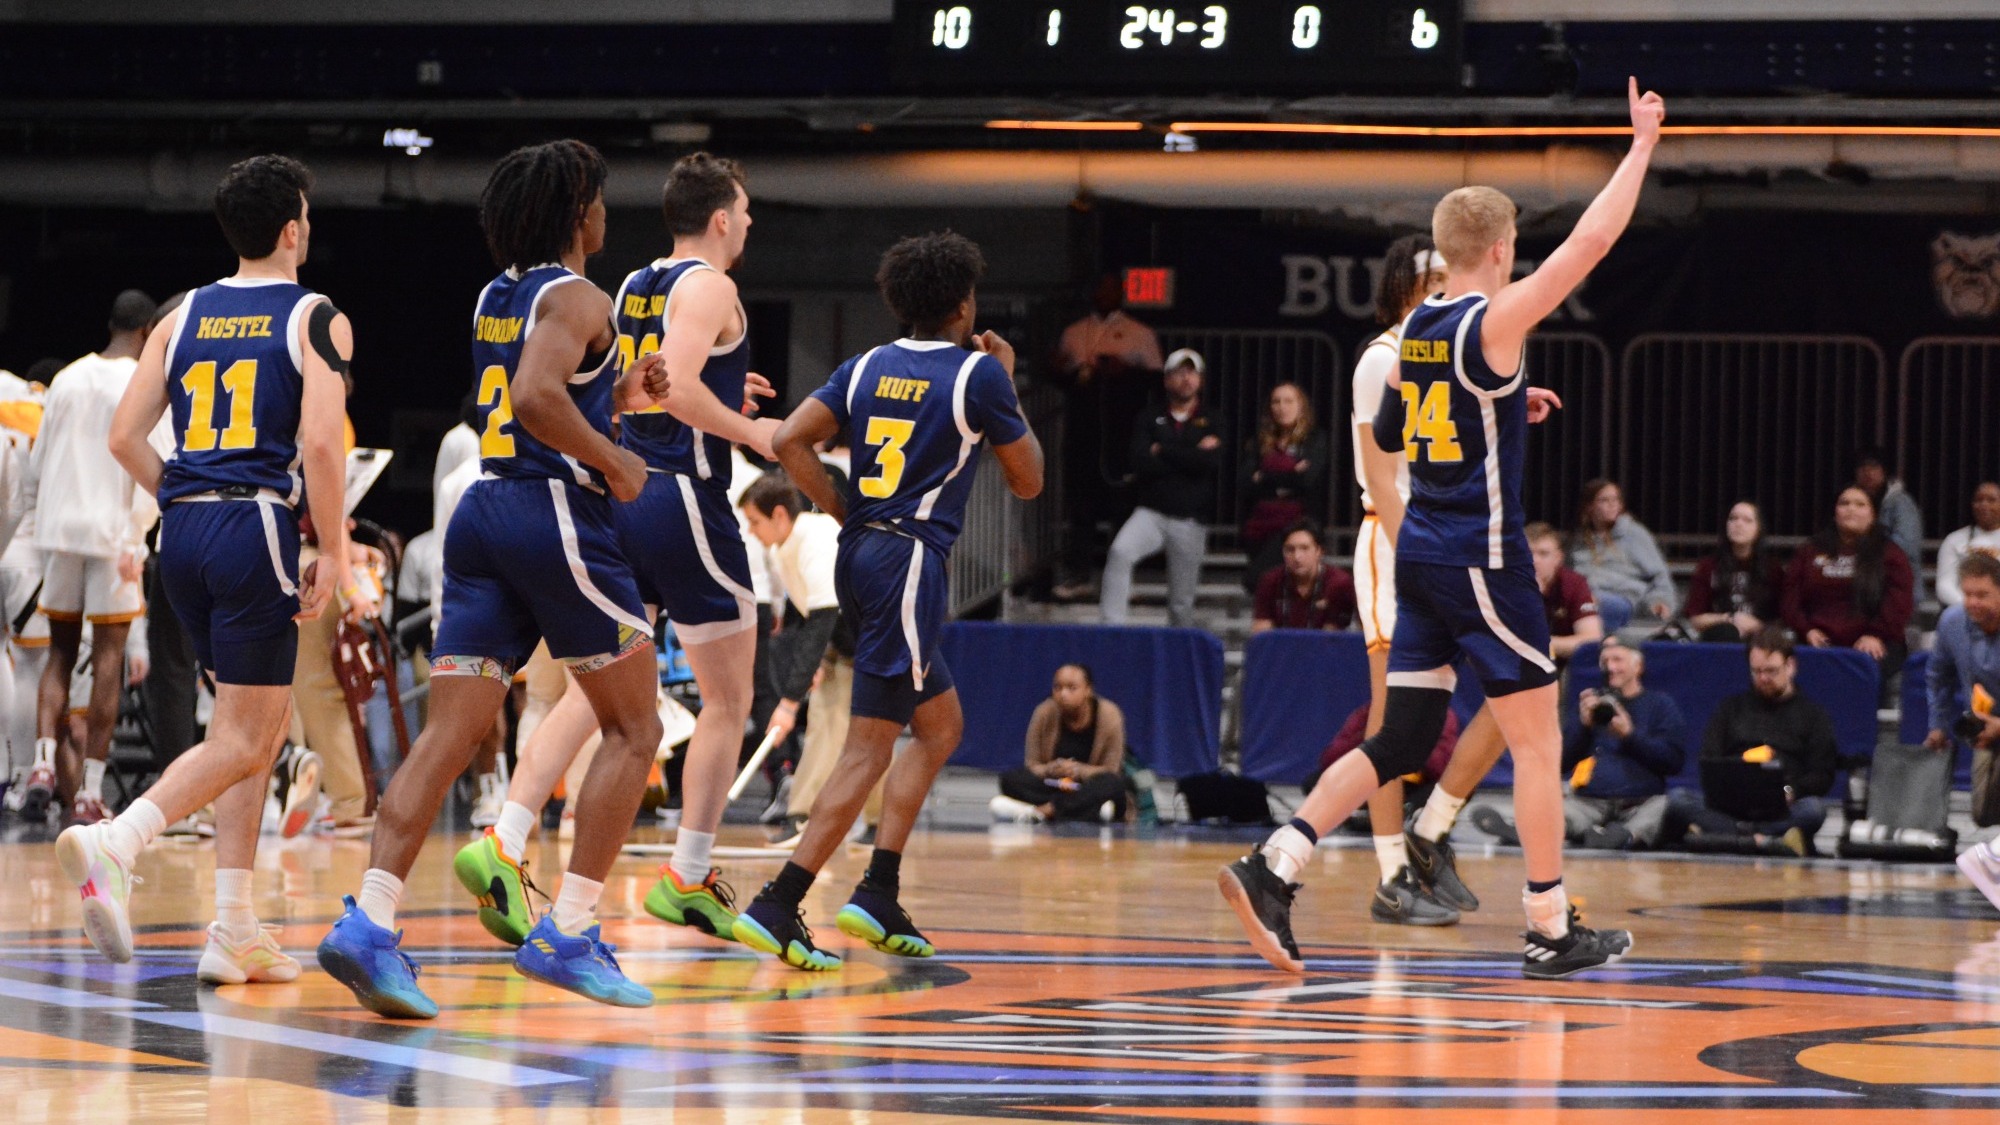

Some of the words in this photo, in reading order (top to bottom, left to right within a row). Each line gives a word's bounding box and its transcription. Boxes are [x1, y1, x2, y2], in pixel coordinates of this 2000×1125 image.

[932, 6, 971, 49] 10
[1046, 8, 1061, 46] 1
[1120, 5, 1228, 49] 24-3
[1292, 5, 1321, 49] 0
[1411, 8, 1439, 49] 6
[1127, 267, 1168, 303] EXIT
[196, 315, 273, 340] KOSTEL
[180, 359, 258, 452] 11
[874, 375, 931, 403] HUFF
[476, 364, 516, 459] 2
[858, 416, 916, 499] 3
